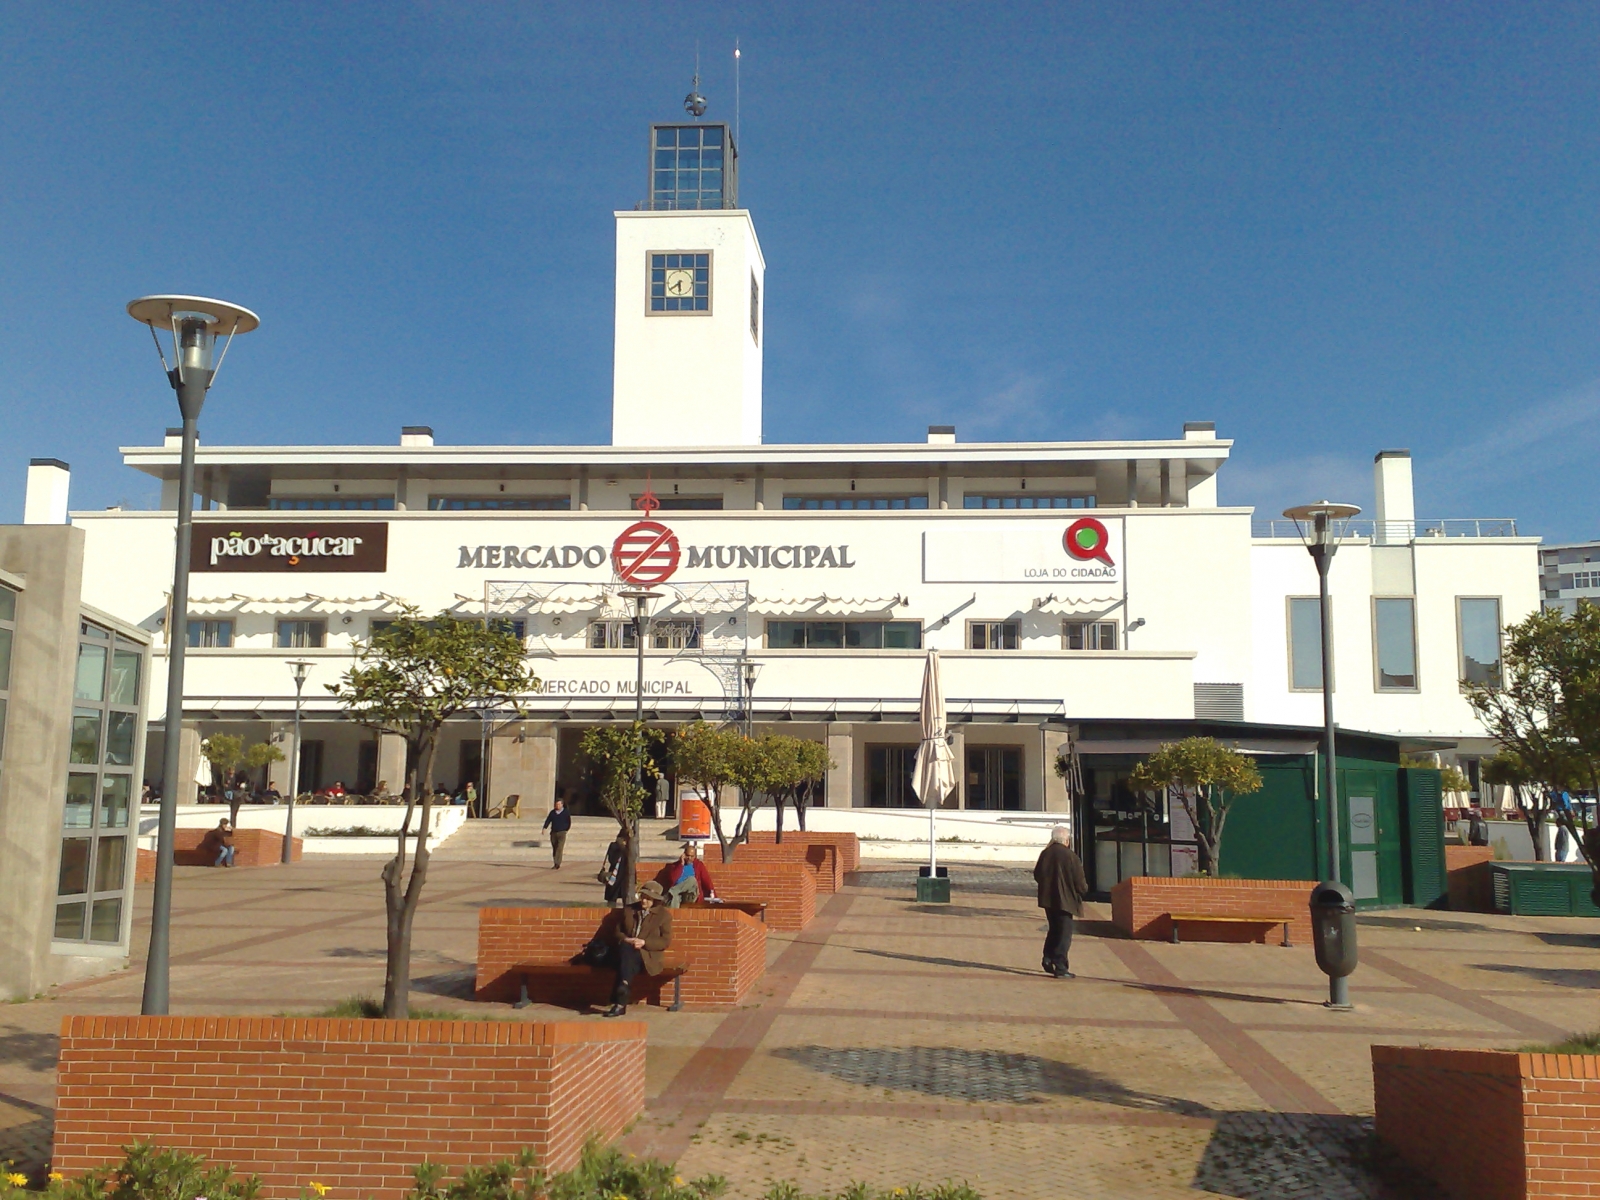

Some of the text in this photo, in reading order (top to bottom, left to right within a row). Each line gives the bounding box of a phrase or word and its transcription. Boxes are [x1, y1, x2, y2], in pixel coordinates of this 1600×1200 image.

[210, 531, 261, 565] pão
[270, 531, 363, 566] açúcar
[456, 545, 856, 569] MERCADO MUNICIPAL
[1024, 566, 1117, 578] LOJA DO CIDADÃO
[538, 680, 693, 694] MERCADO MUNICIPAL
